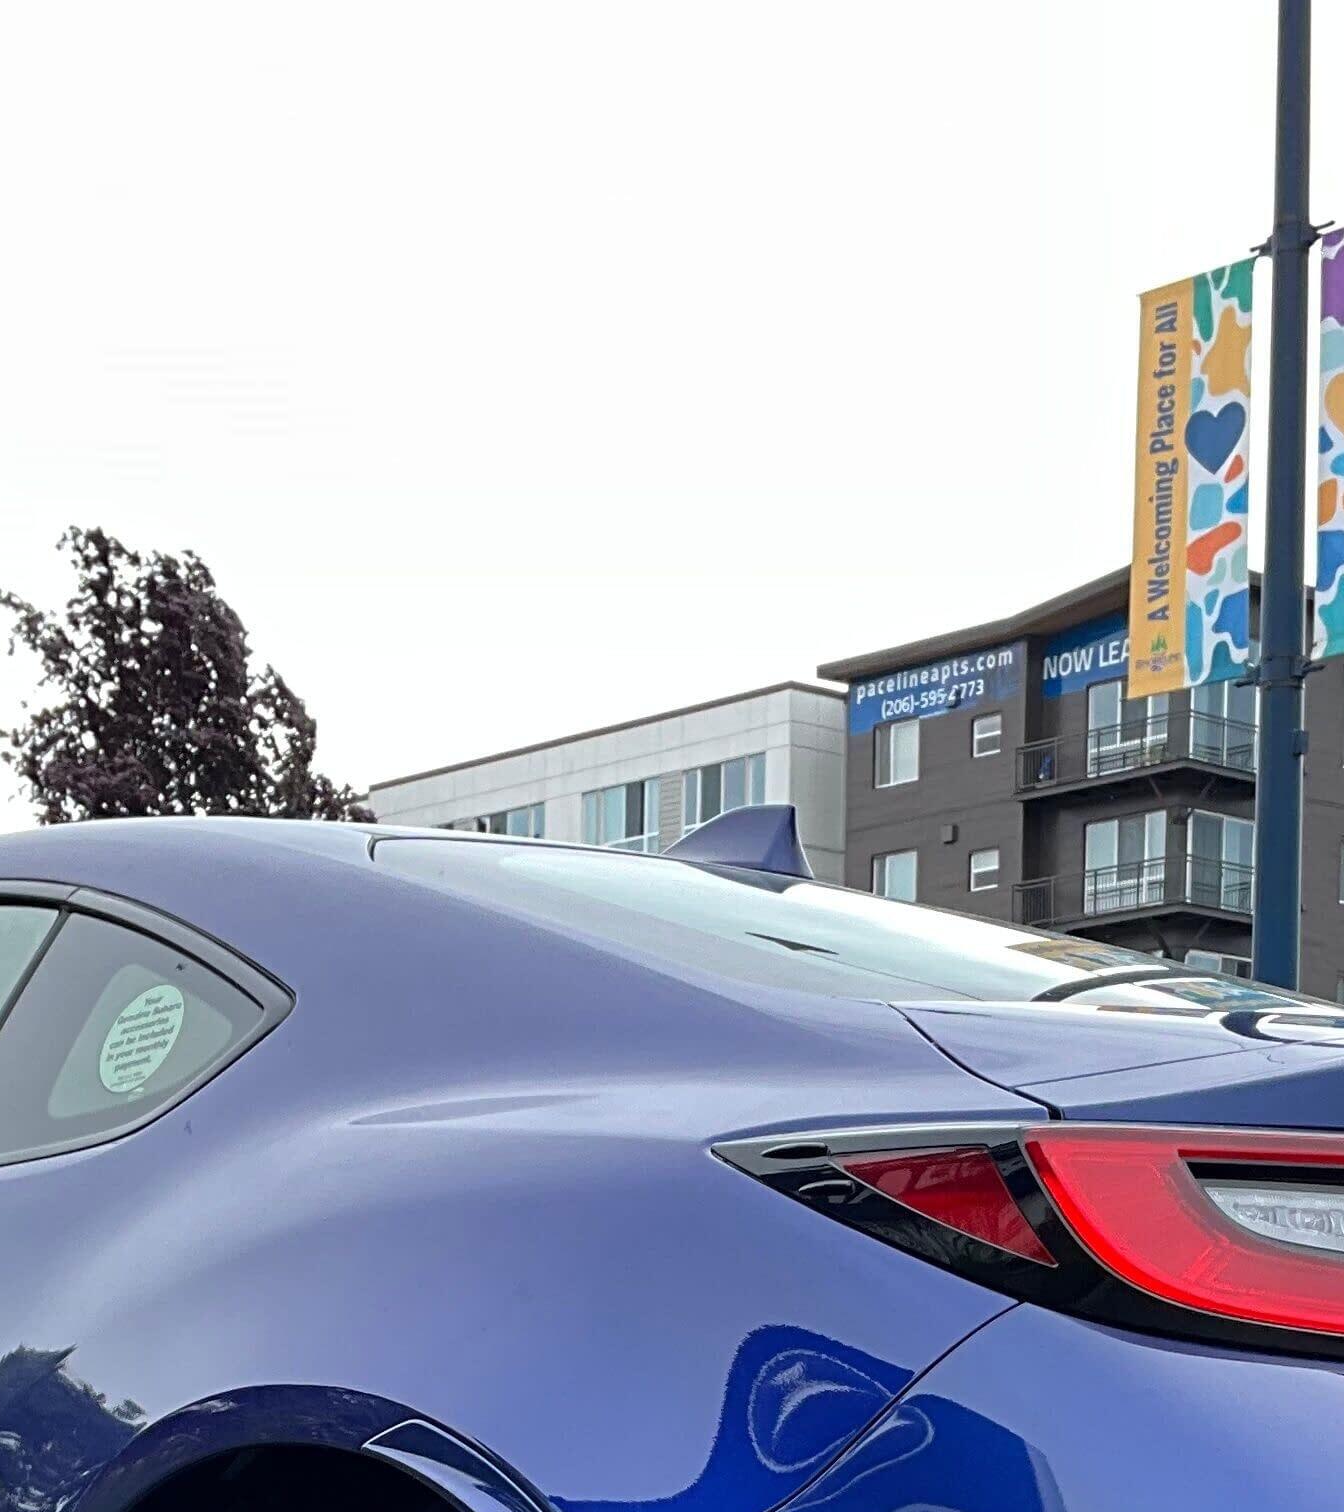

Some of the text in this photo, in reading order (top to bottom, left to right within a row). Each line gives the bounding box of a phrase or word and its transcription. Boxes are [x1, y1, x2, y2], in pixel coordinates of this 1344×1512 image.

[1147, 301, 1179, 622] A Welcoming Place for All
[856, 650, 1014, 706] pacelineapts.com
[1043, 647, 1095, 681] NOW
